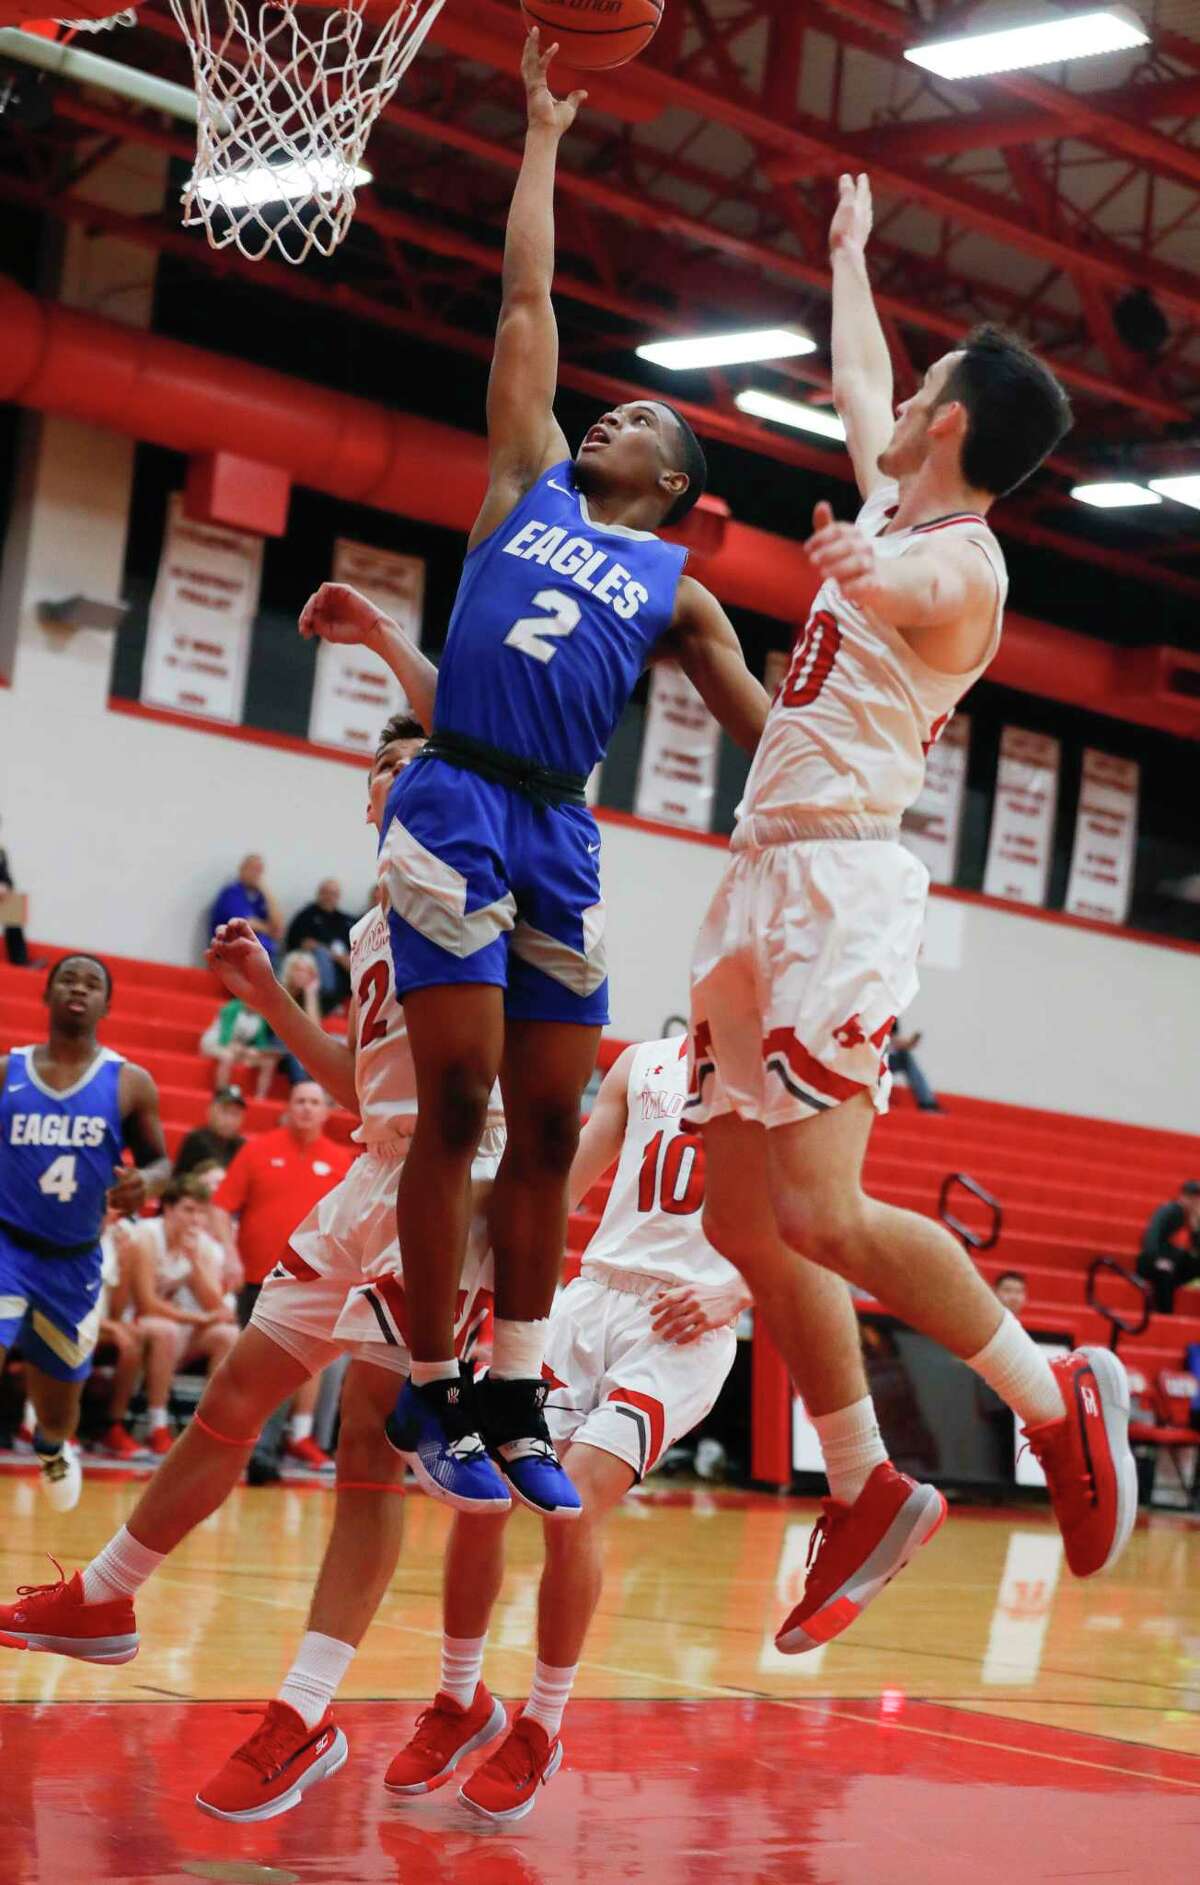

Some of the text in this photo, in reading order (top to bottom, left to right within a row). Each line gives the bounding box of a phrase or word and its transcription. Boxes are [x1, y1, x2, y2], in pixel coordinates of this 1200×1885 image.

[502, 519, 650, 620] EAGLES
[502, 588, 583, 665] 2
[770, 609, 844, 709] 0
[358, 959, 391, 1050] 2
[9, 1113, 108, 1148] EAGLES
[637, 1129, 706, 1216] 10
[38, 1154, 79, 1203] 4
